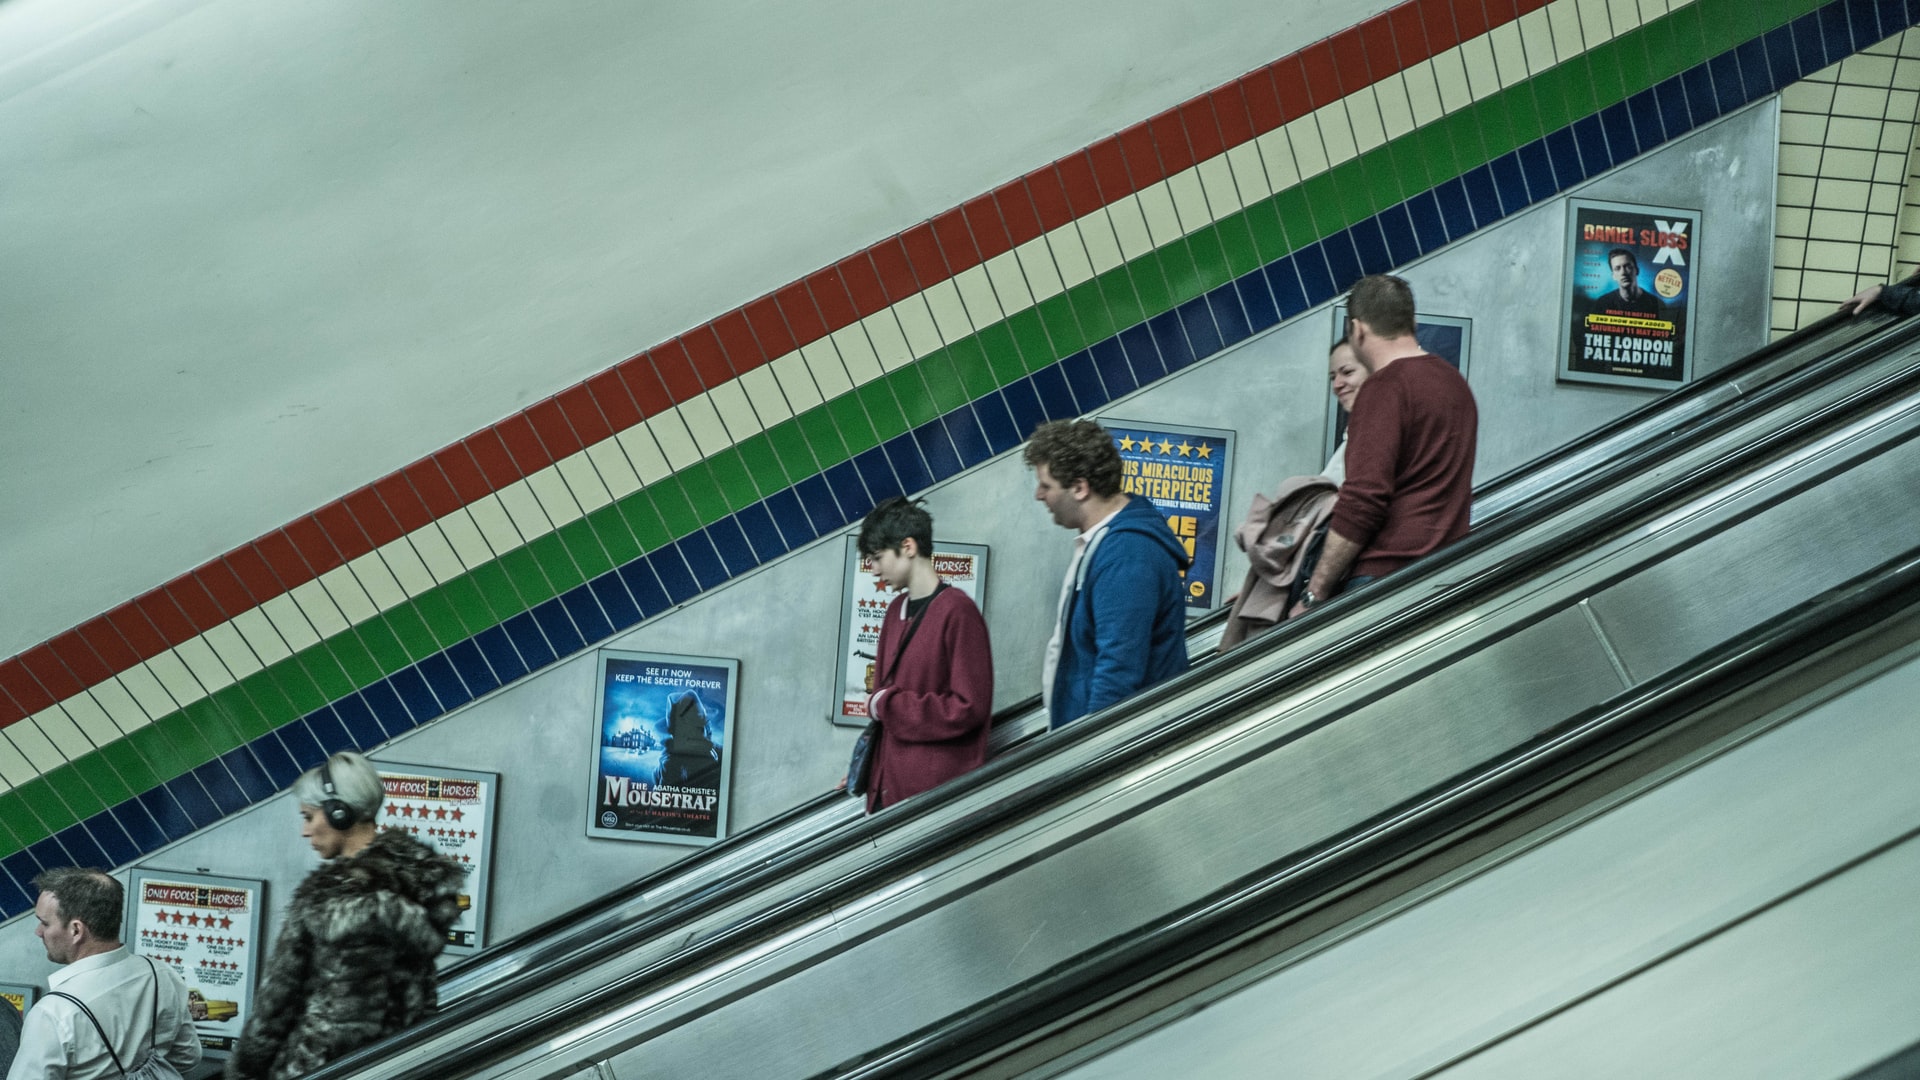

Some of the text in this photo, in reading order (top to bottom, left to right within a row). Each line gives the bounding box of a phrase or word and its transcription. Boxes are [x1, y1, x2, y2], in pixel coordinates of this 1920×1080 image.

[1584, 224, 1688, 250] DANIEL SLOSS
[1658, 274, 1681, 288] NETFLIX
[1591, 324, 1624, 333] SATURDAY
[1636, 328, 1651, 336] MAY
[1652, 330, 1670, 338] 2019
[1584, 333, 1673, 354] THE LONDON
[1584, 346, 1672, 367] PALLADIUM
[1142, 462, 1214, 484] MIRACULOUS
[934, 560, 970, 572] HORSES
[646, 667, 692, 678] SEE IT NOW
[615, 674, 721, 689] KEEP THE SECRET FOREVER
[382, 781, 398, 792] NLY
[400, 782, 425, 793] FOOLS
[443, 785, 476, 797] HORSES
[603, 775, 717, 811] MOUSETRAP
[631, 782, 716, 796] THE AGATHA CHRISTIE'S
[147, 888, 169, 899] ONLY
[170, 889, 195, 901] FOOLS
[212, 894, 245, 906] HORSES
